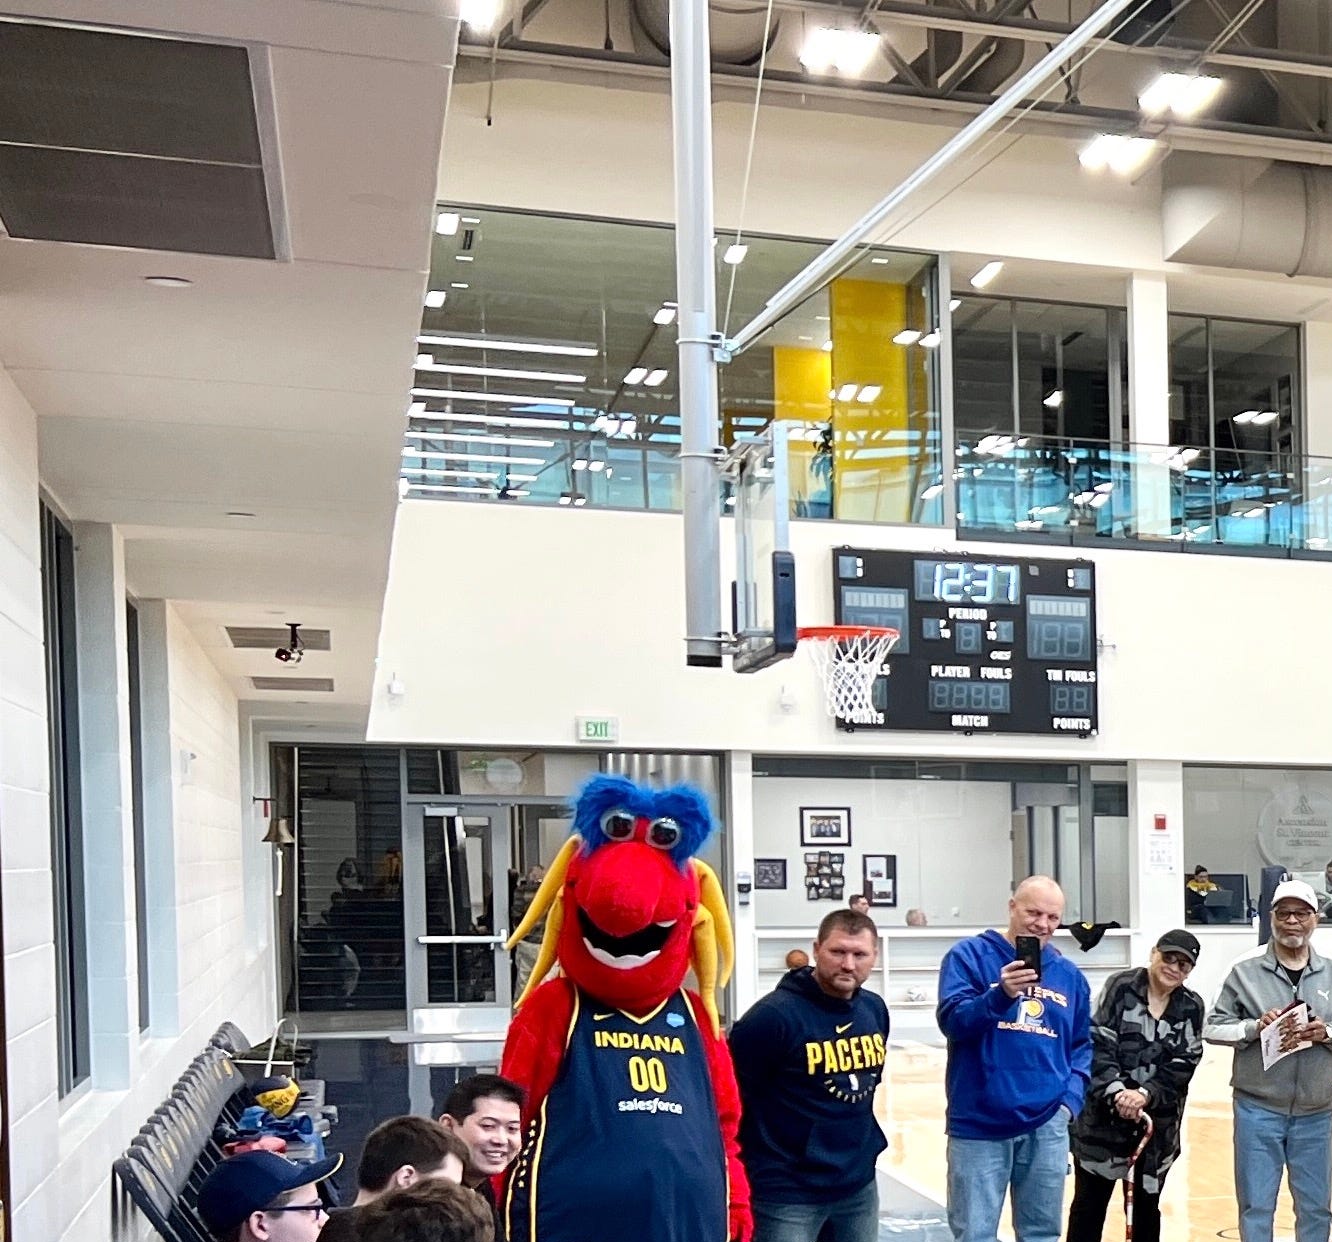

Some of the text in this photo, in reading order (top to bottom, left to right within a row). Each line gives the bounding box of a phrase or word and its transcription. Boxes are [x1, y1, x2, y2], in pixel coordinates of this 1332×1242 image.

[933, 563, 1017, 602] 12:37
[948, 607, 987, 620] PERIOD
[931, 665, 1012, 680] PLAYER FOULS
[1065, 670, 1096, 682] FOULS
[951, 714, 989, 727] MATCH
[1053, 717, 1091, 730] POINTS
[586, 721, 609, 737] EXIT
[997, 1021, 1059, 1038] BASKETBALL
[594, 1031, 685, 1055] INDIANA
[805, 1033, 886, 1075] PACERS
[628, 1056, 668, 1094] 00
[618, 1097, 684, 1115] salesforce
